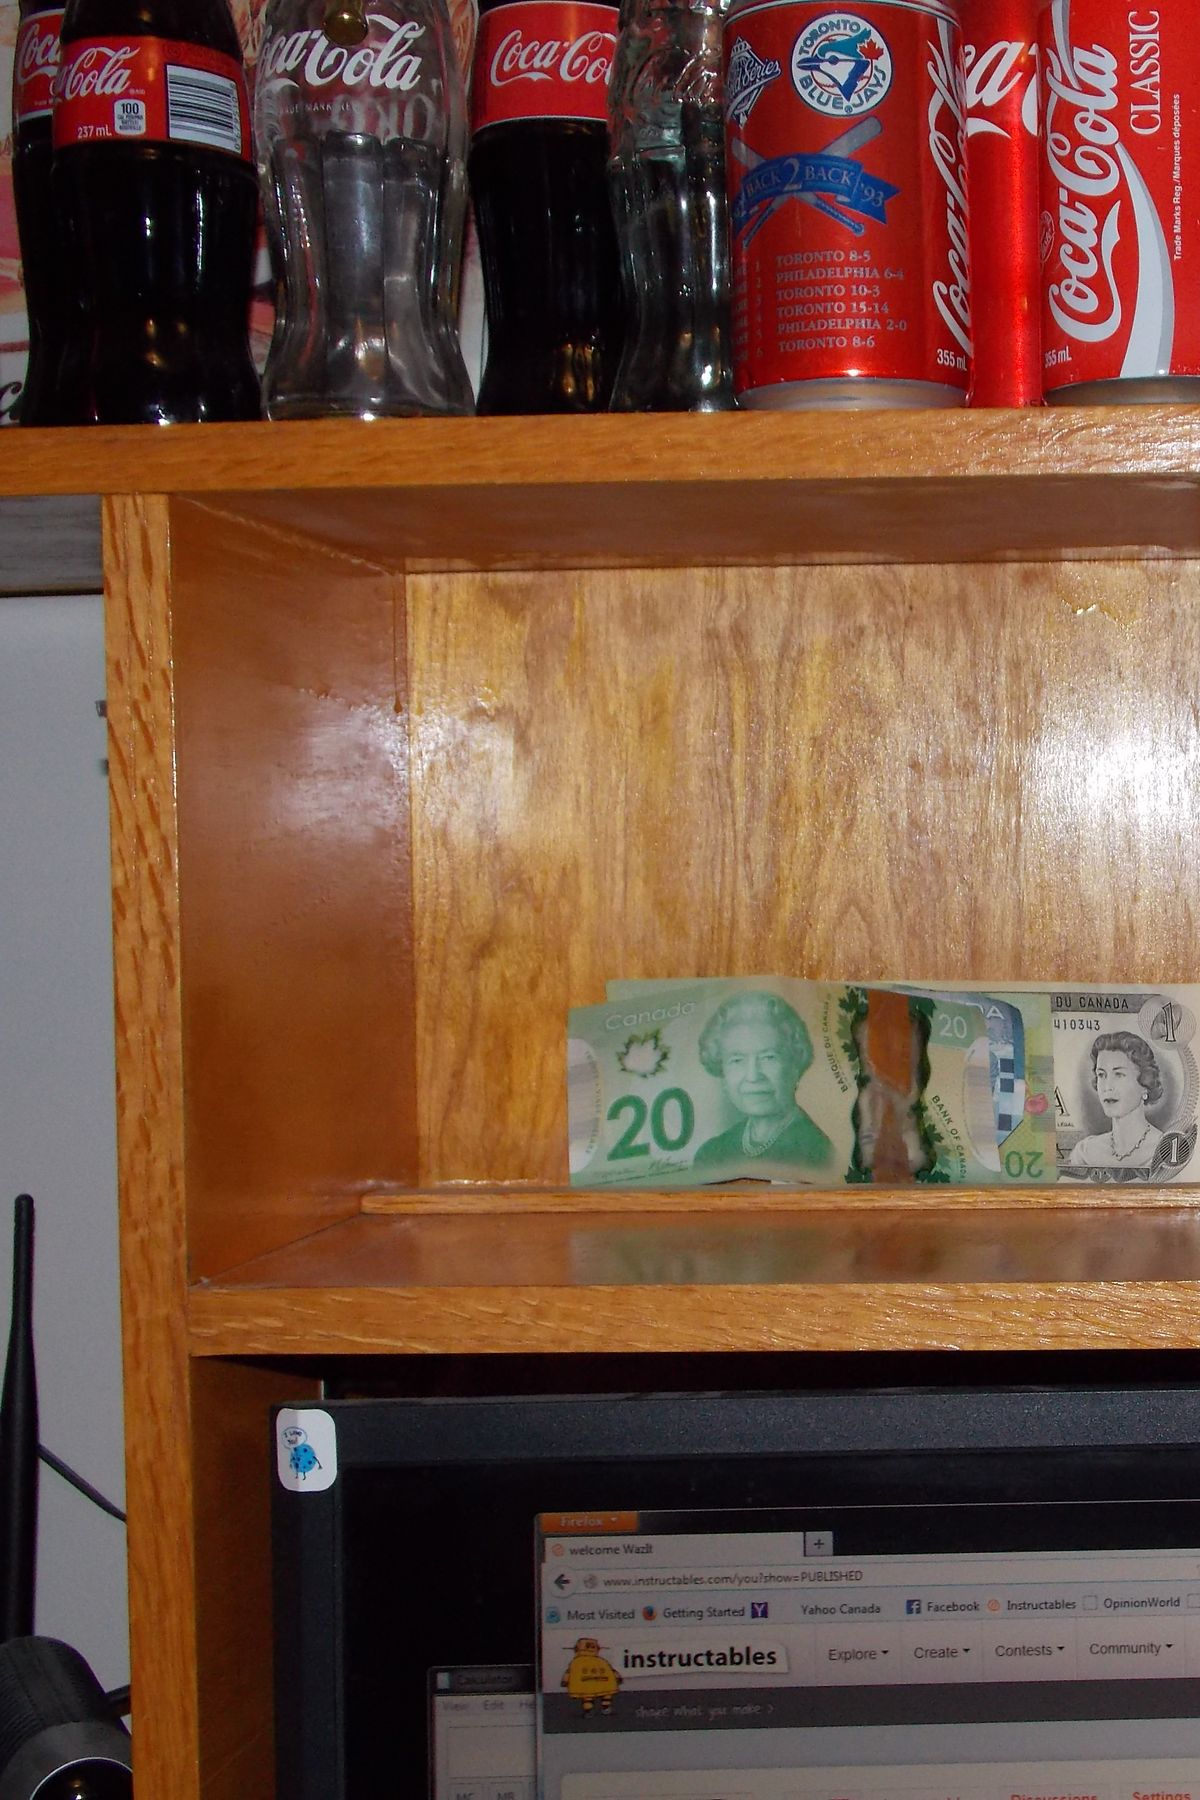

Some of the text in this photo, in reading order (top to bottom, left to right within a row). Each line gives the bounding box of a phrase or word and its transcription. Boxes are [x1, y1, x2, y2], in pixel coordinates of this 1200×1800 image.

[799, 19, 861, 56] TORONTO
[490, 29, 617, 87] Coca-Co
[1129, 10, 1161, 135] CLASSIC
[799, 65, 887, 110] BLUE JAYS
[120, 102, 139, 114] 100
[1171, 94, 1182, 138] déposées
[77, 123, 112, 139] 237 mL
[746, 170, 781, 194] BACK
[783, 158, 802, 191] 2
[805, 165, 853, 186] BACK
[1046, 43, 1122, 342] Coca-Cola
[1173, 205, 1182, 233] Marks
[1173, 234, 1182, 261] Trade
[776, 250, 871, 268] TORONTO 8-5
[776, 267, 880, 283] PHILADELPHIA
[776, 284, 880, 301] TORONTO 10-3
[777, 301, 889, 318] TORONTO 15-14
[778, 319, 881, 334] PHILADELPHIA
[779, 335, 875, 353] TORONTO 8-6
[937, 349, 956, 366] 355
[1057, 345, 1073, 364] mL
[1056, 997, 1129, 1010] DU CANADA
[606, 1001, 697, 1031] Canada
[1054, 1018, 1100, 1031] 410343
[939, 1014, 968, 1039] 20
[606, 1087, 695, 1162] 20
[931, 1095, 953, 1126] BANK
[951, 1127, 962, 1141] OF
[1170, 1137, 1178, 1163] 1
[1005, 1151, 1044, 1179] 20
[569, 1545, 620, 1556] welcome
[801, 1602, 881, 1616] Yahoo Canada
[927, 1600, 980, 1612] Facebook
[1007, 1598, 1077, 1611] Instructables
[1103, 1596, 1181, 1610] OpinionWorld
[567, 1608, 636, 1621] Most Visited
[663, 1605, 745, 1620] Getting Started
[623, 1647, 777, 1668] instructables
[828, 1648, 877, 1662] Explore
[914, 1646, 958, 1659] Create
[995, 1644, 1053, 1658] Contests
[1089, 1642, 1161, 1657] Community
